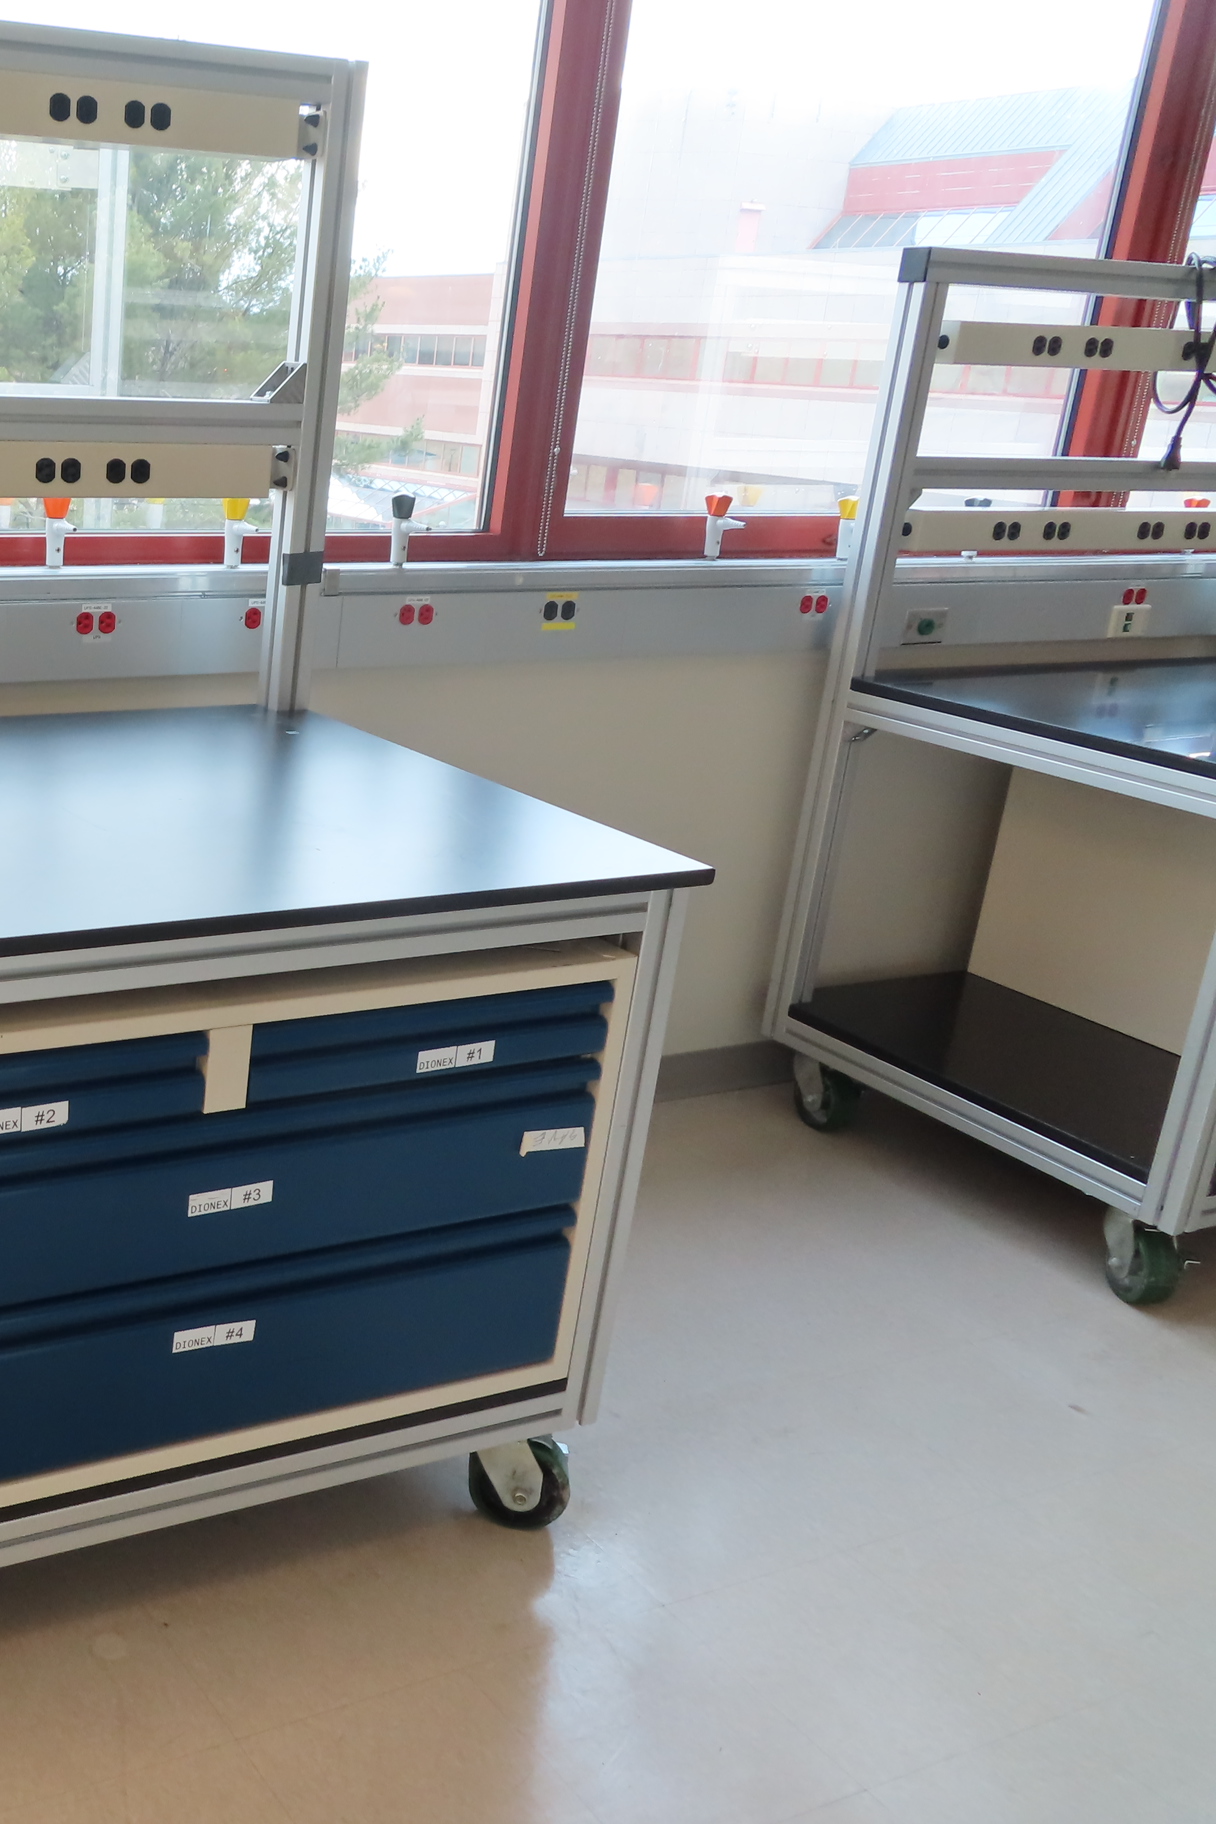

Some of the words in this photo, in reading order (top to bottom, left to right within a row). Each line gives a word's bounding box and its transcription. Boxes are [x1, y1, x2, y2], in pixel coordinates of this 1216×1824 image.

[418, 1057, 454, 1071] DIONEX
[466, 1047, 483, 1062] #1
[34, 1109, 56, 1126] #2
[190, 1199, 229, 1214] DIONEX
[242, 1188, 262, 1204] #3
[174, 1335, 213, 1350] DIONEX
[225, 1326, 244, 1341] #4
